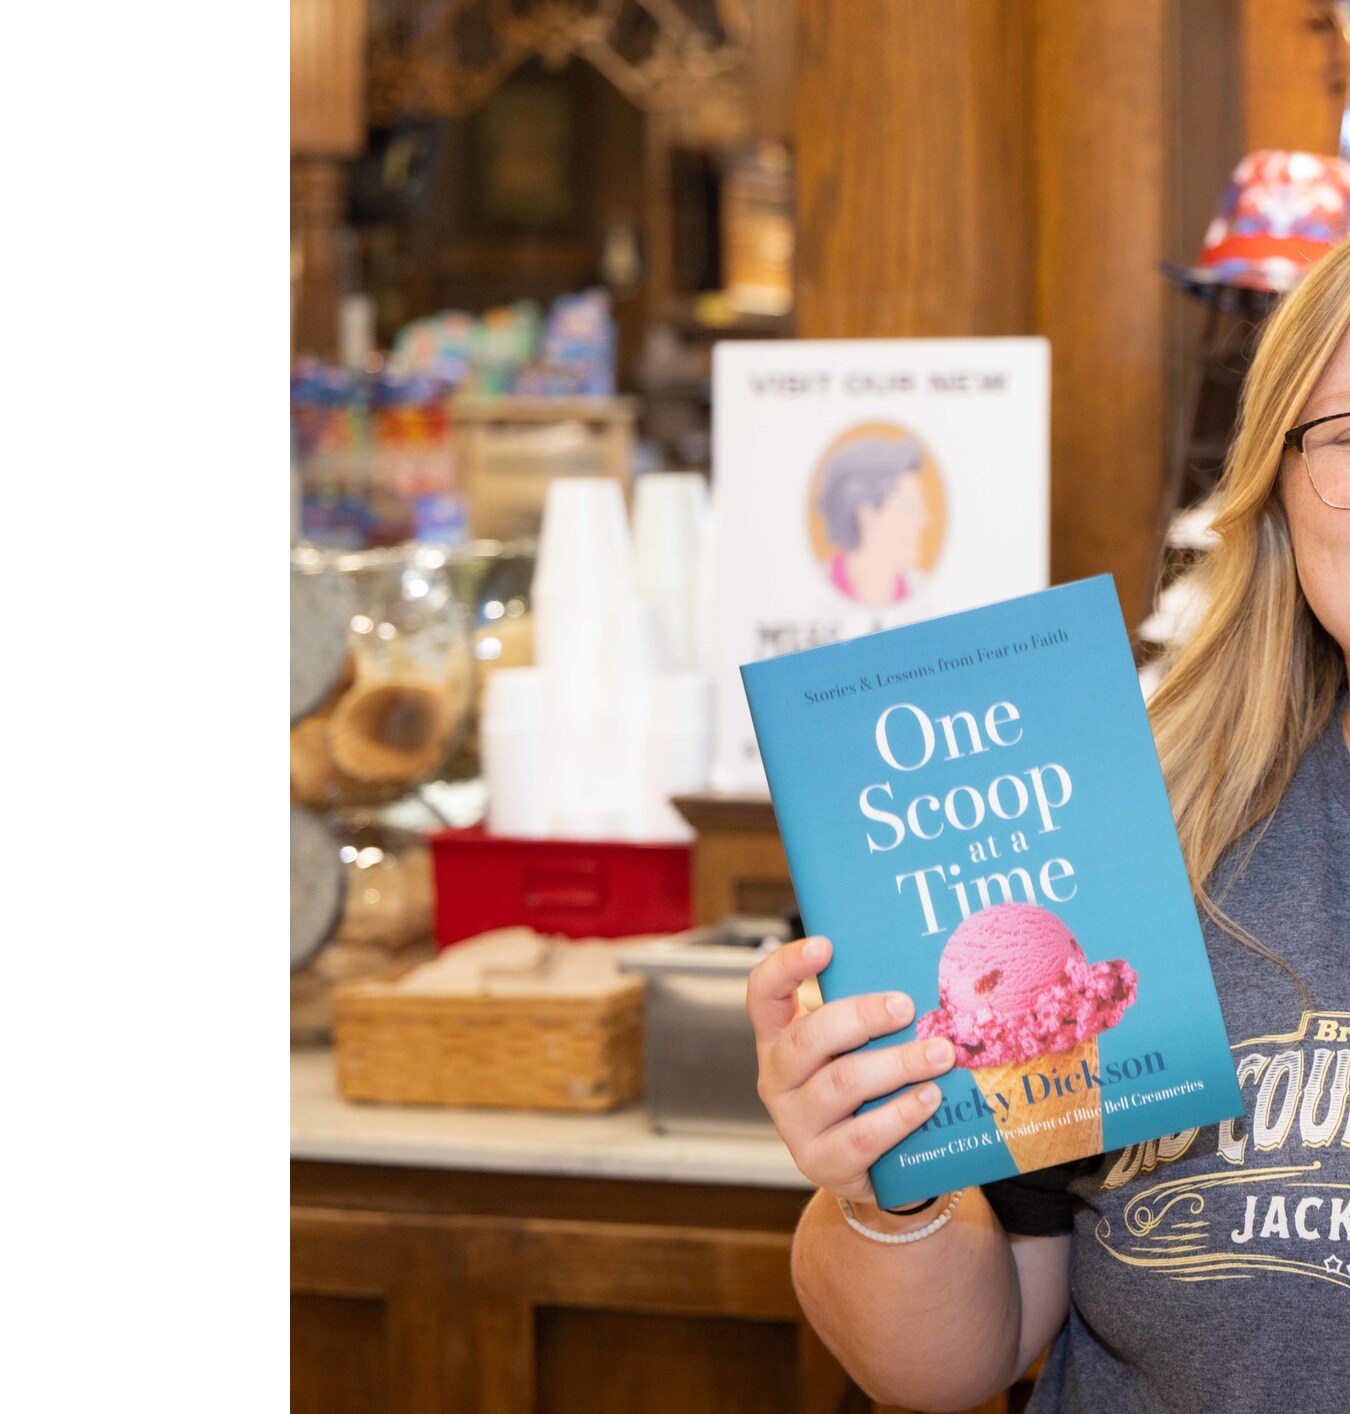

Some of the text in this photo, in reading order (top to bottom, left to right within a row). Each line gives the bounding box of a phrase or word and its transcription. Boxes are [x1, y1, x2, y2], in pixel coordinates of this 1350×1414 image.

[750, 371, 1009, 394] VISIT OUR NEW
[804, 628, 1069, 705] Stories & Lessons from Fear to Faith
[875, 701, 1023, 771] One
[858, 762, 1073, 854] Scoop
[968, 830, 1030, 863] at a
[895, 857, 1078, 937] Time
[1021, 1049, 1167, 1105] Dickson
[899, 1079, 1205, 1168] Former CEO & President of Blue Bell Creameries
